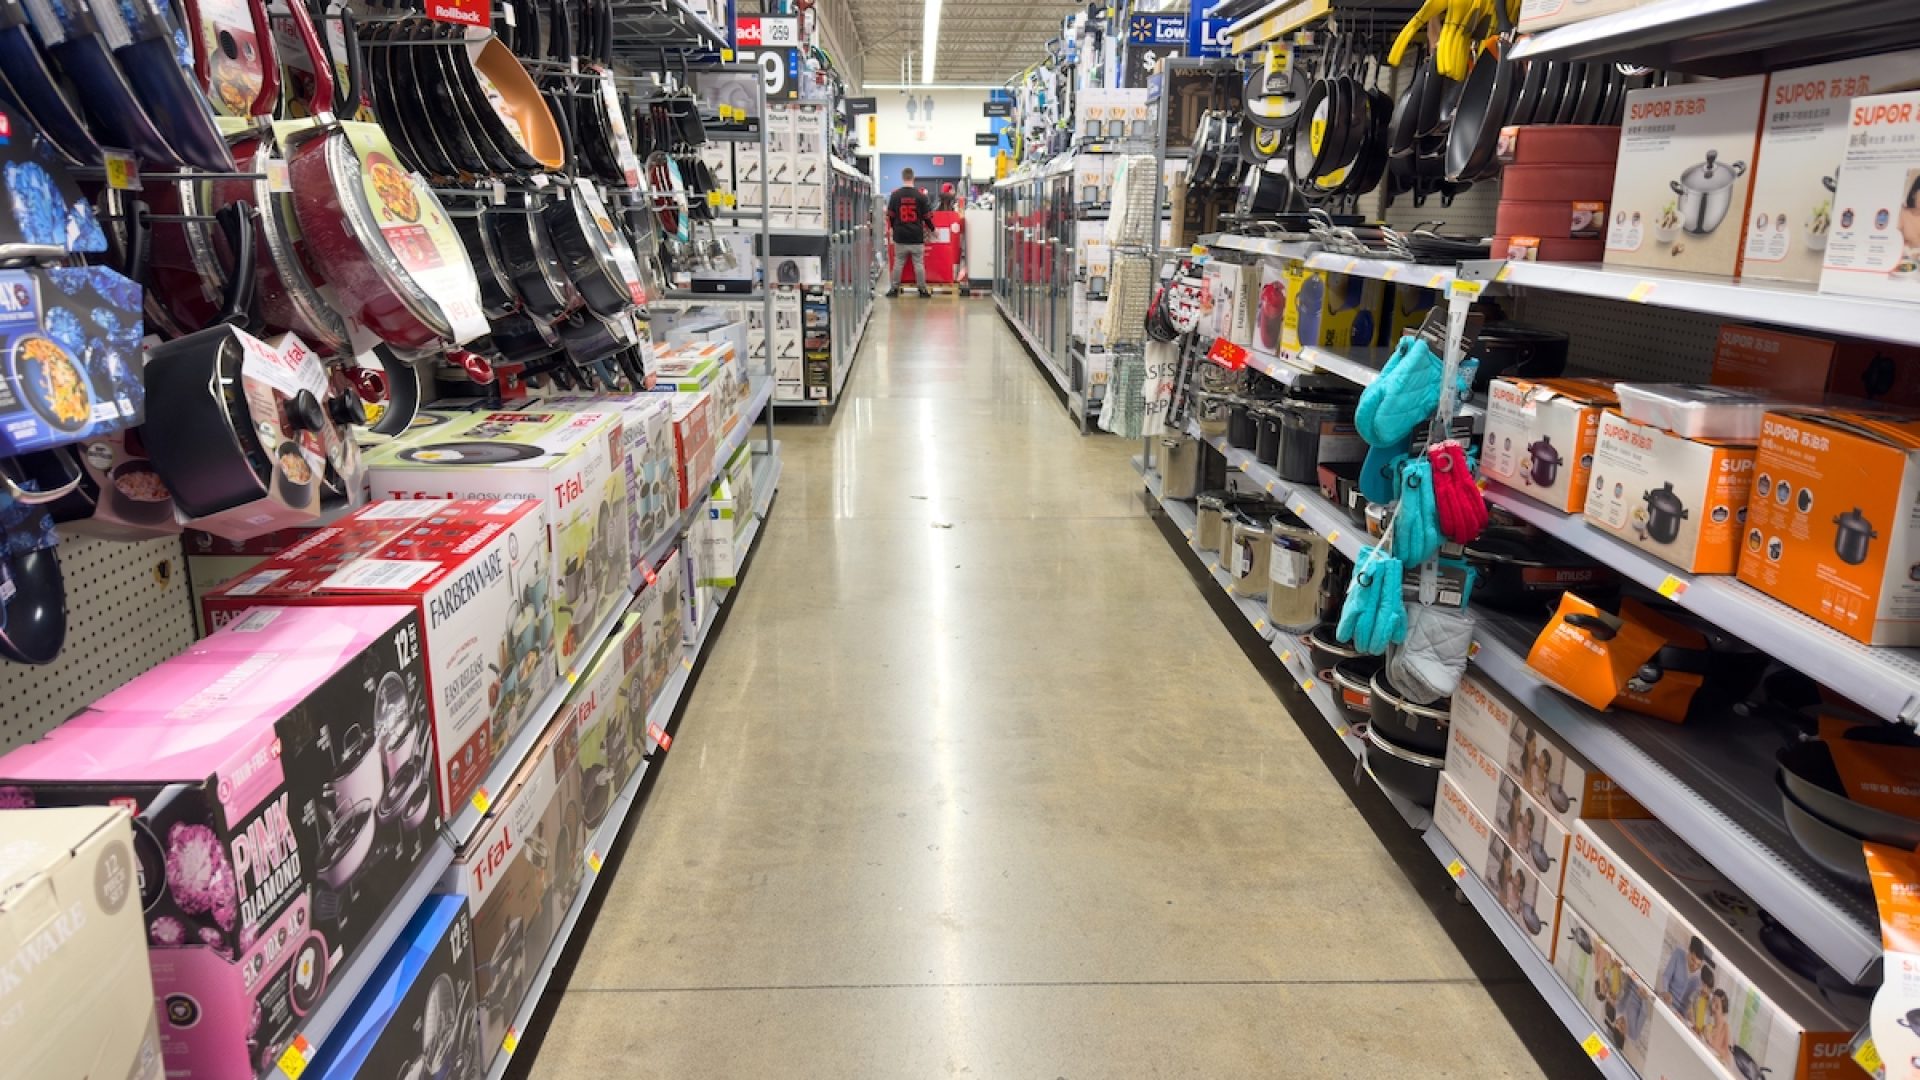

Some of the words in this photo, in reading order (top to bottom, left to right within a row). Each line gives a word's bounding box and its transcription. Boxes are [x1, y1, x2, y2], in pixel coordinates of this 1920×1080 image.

[436, 5, 481, 22] Rollback
[1156, 26, 1186, 38] Low
[1774, 79, 1827, 105] SUPOR
[1829, 74, 1871, 99] 苏泊尔
[1630, 101, 1671, 121] SUPOR
[1674, 97, 1706, 116] 苏泊尔
[1853, 103, 1912, 127] SUPOR
[1722, 332, 1755, 350] SUPOR
[1492, 387, 1515, 405] SUPOR
[1604, 423, 1631, 442] SUPOR
[1762, 420, 1799, 443] SUPOR
[1799, 431, 1830, 452] 苏泊尔
[554, 471, 584, 510] T-fal
[430, 548, 504, 630] FARBERWARE
[1558, 623, 1585, 644] SUPOR
[394, 628, 412, 671] 12
[1460, 678, 1487, 709] SUPOR
[1454, 728, 1478, 765] SUPOR
[1442, 783, 1468, 821] SUPOR
[231, 791, 298, 903] PINK
[473, 825, 513, 892] T-fal
[103, 853, 120, 880] 12
[1575, 834, 1617, 885] SUPOR
[1617, 874, 1652, 919] 苏泊尔
[241, 852, 301, 929] DIAMOND
[450, 922, 463, 964] 12
